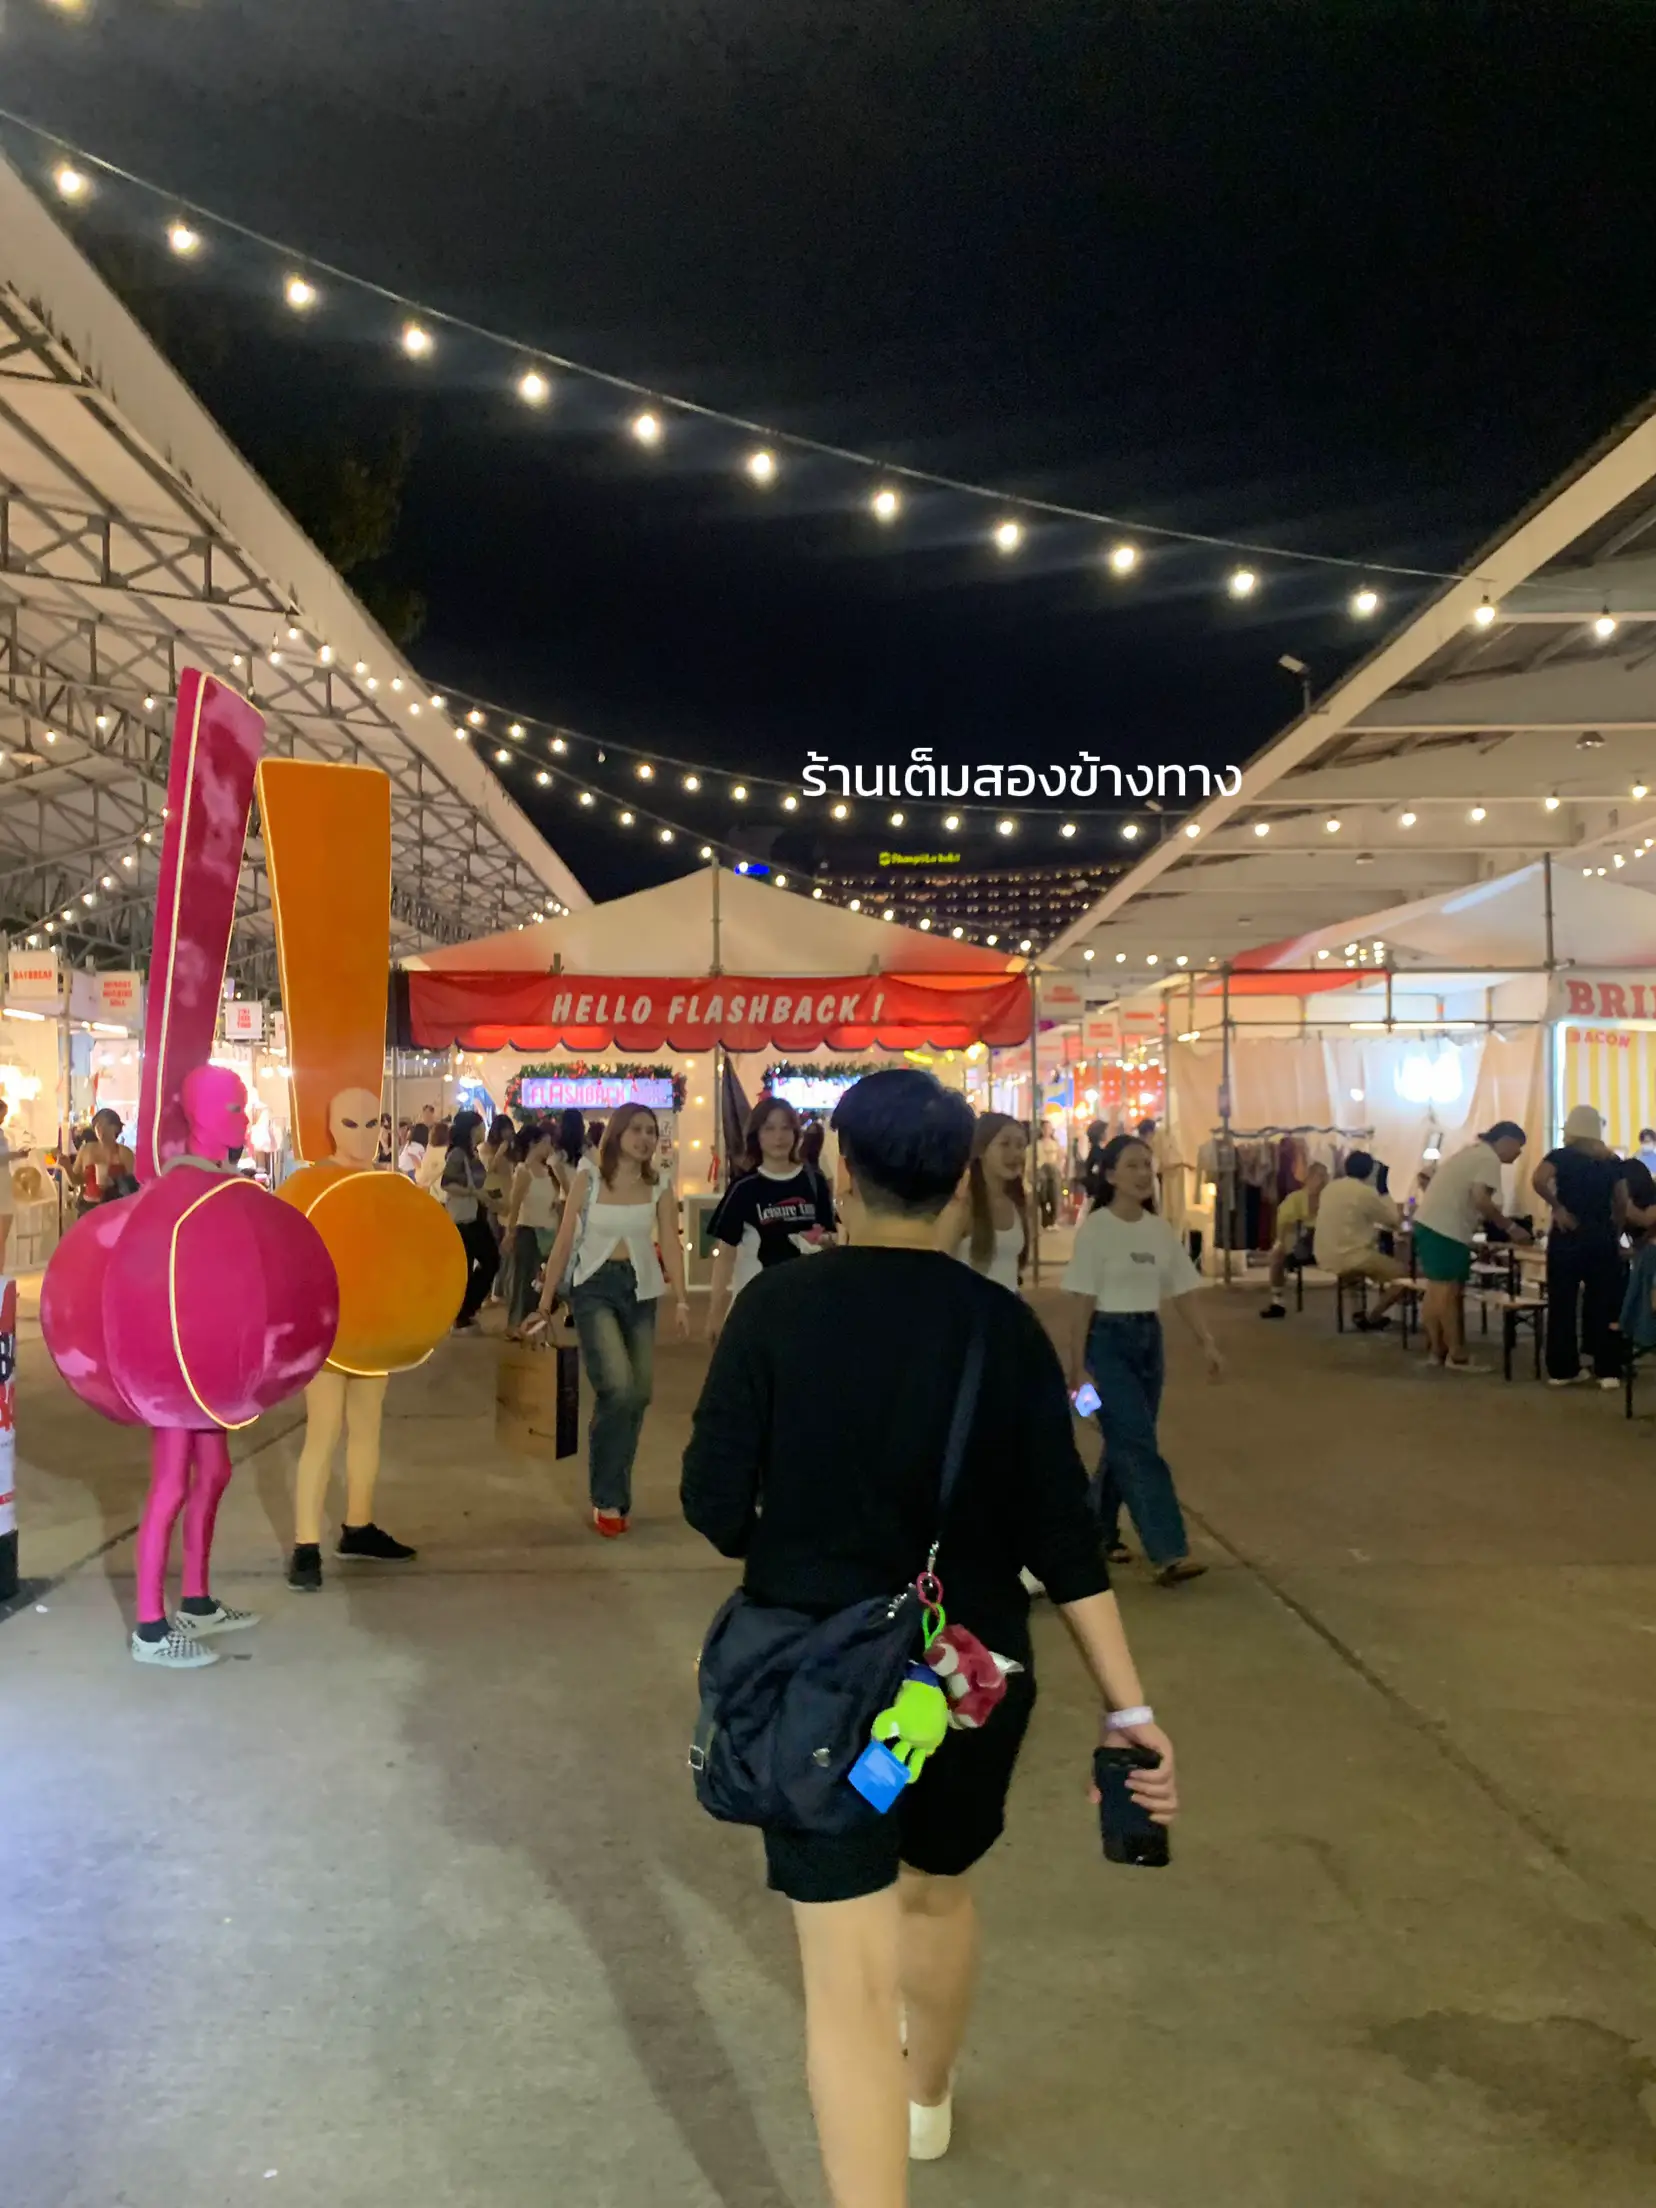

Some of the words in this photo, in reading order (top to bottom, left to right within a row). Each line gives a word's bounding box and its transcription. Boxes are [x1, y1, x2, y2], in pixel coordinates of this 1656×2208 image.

[551, 993, 652, 1024] HELLO
[667, 994, 861, 1025] FLASHBACK
[1565, 979, 1656, 1020] BRI
